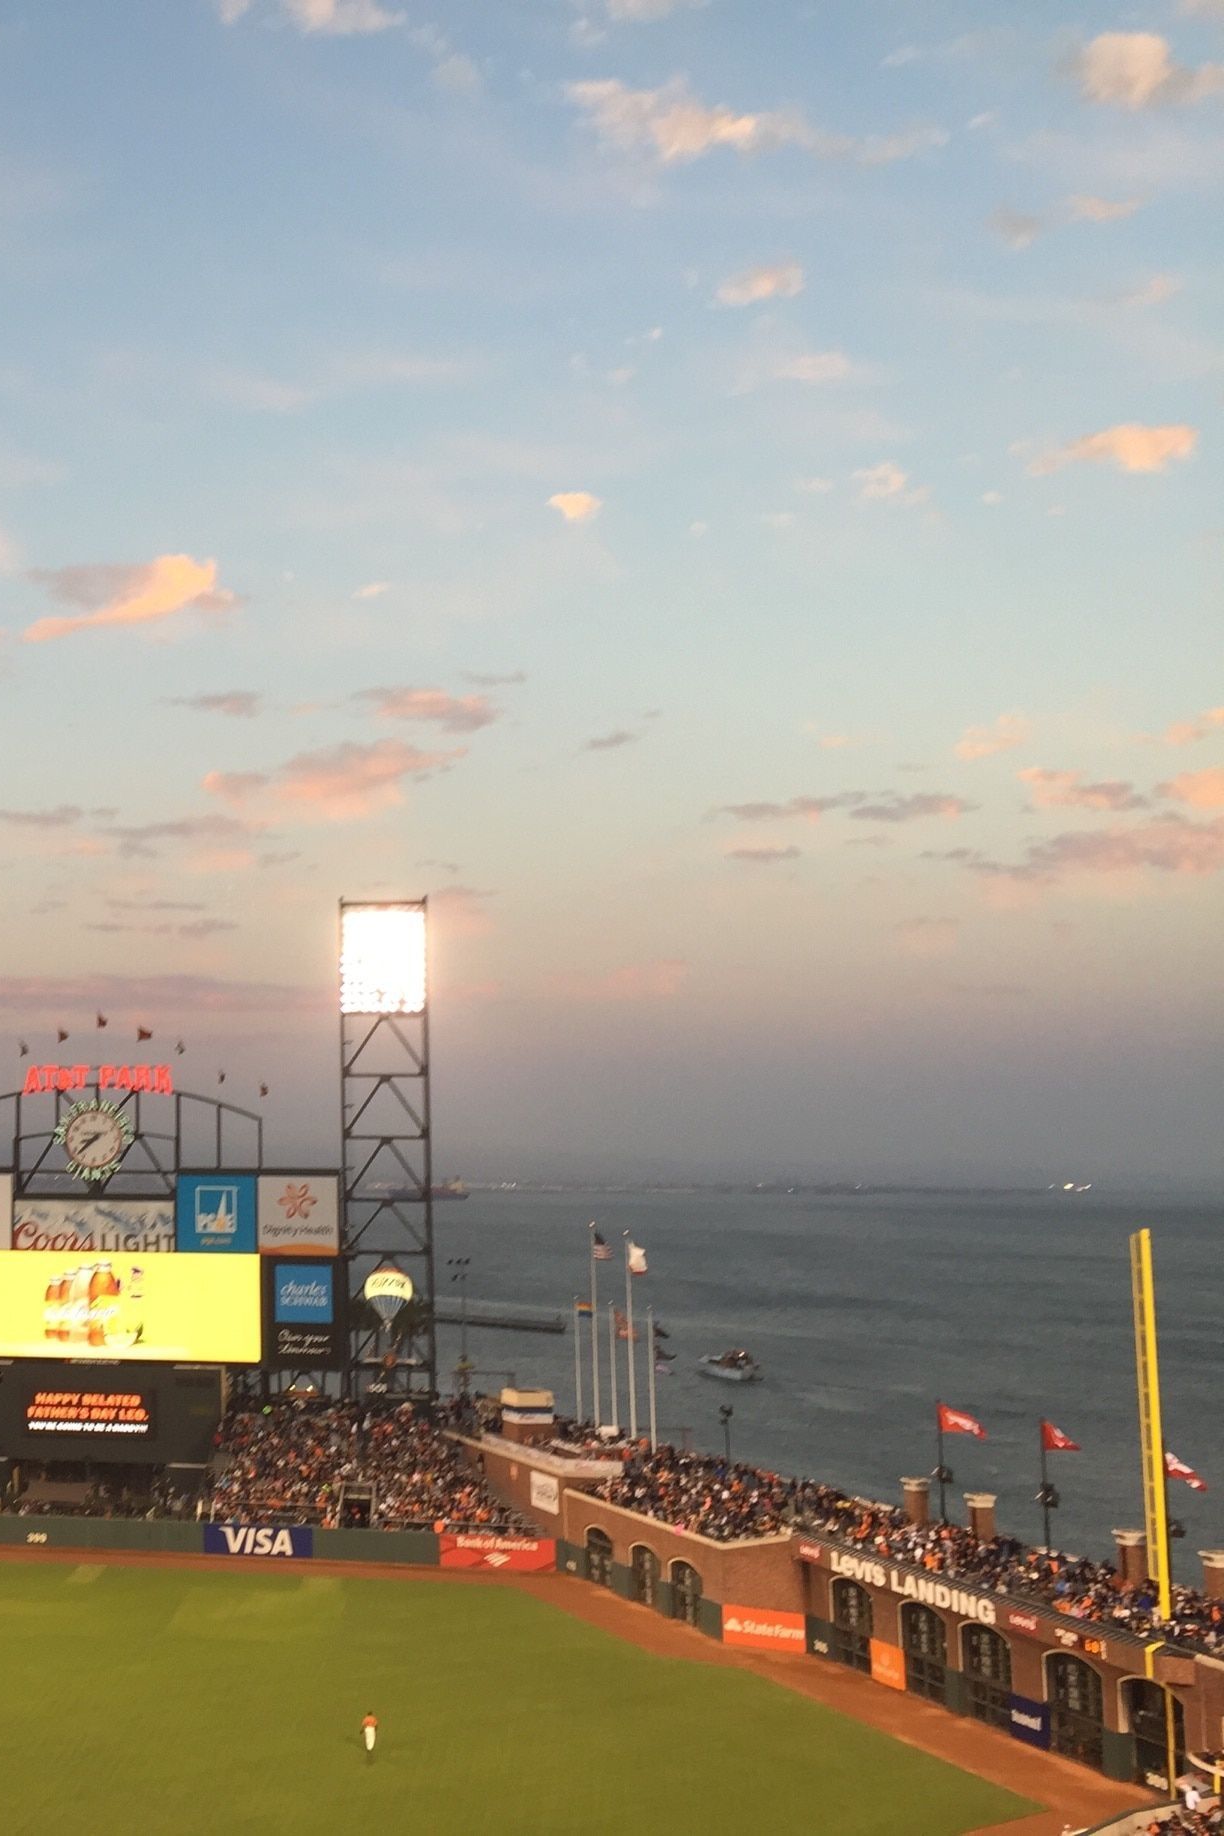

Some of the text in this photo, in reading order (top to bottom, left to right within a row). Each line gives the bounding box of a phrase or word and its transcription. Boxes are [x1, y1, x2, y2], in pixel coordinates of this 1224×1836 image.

[98, 1065, 174, 1097] PARK
[11, 1220, 176, 1253] Coors LIGHT
[27, 1406, 90, 1420] FATHER'S
[90, 1407, 118, 1420] DAY
[35, 1392, 141, 1407] HAPPY BELATED
[218, 1525, 294, 1556] VISA
[456, 1535, 483, 1549] Bank
[495, 1538, 539, 1551] America
[890, 1570, 997, 1625] LANDING
